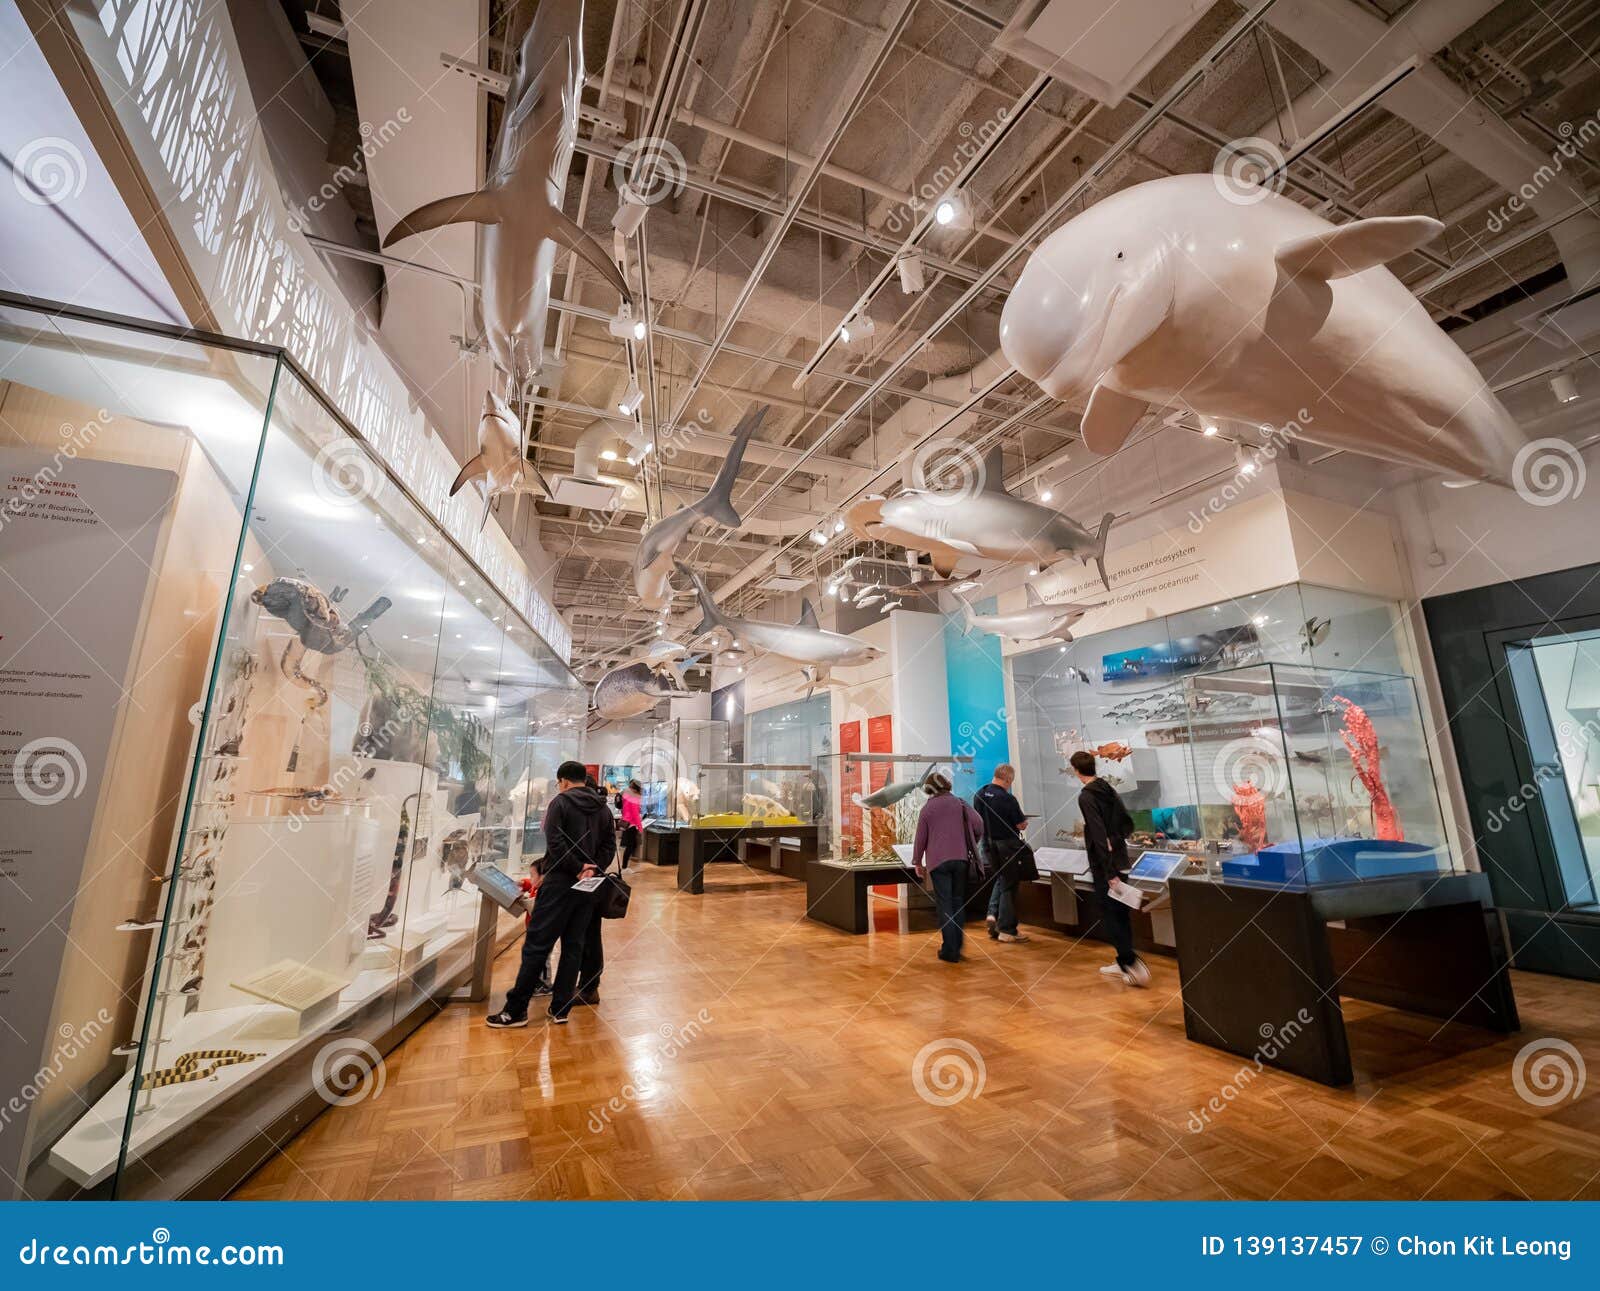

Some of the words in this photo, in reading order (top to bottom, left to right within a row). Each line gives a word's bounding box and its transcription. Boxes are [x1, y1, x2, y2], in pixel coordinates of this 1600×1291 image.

[12, 476, 31, 484] LIFE
[47, 480, 77, 489] CRISIS
[48, 503, 95, 516] Biodiversity
[1118, 568, 1132, 579] this
[1132, 561, 1154, 573] ocean
[1155, 546, 1196, 565] ecosystem
